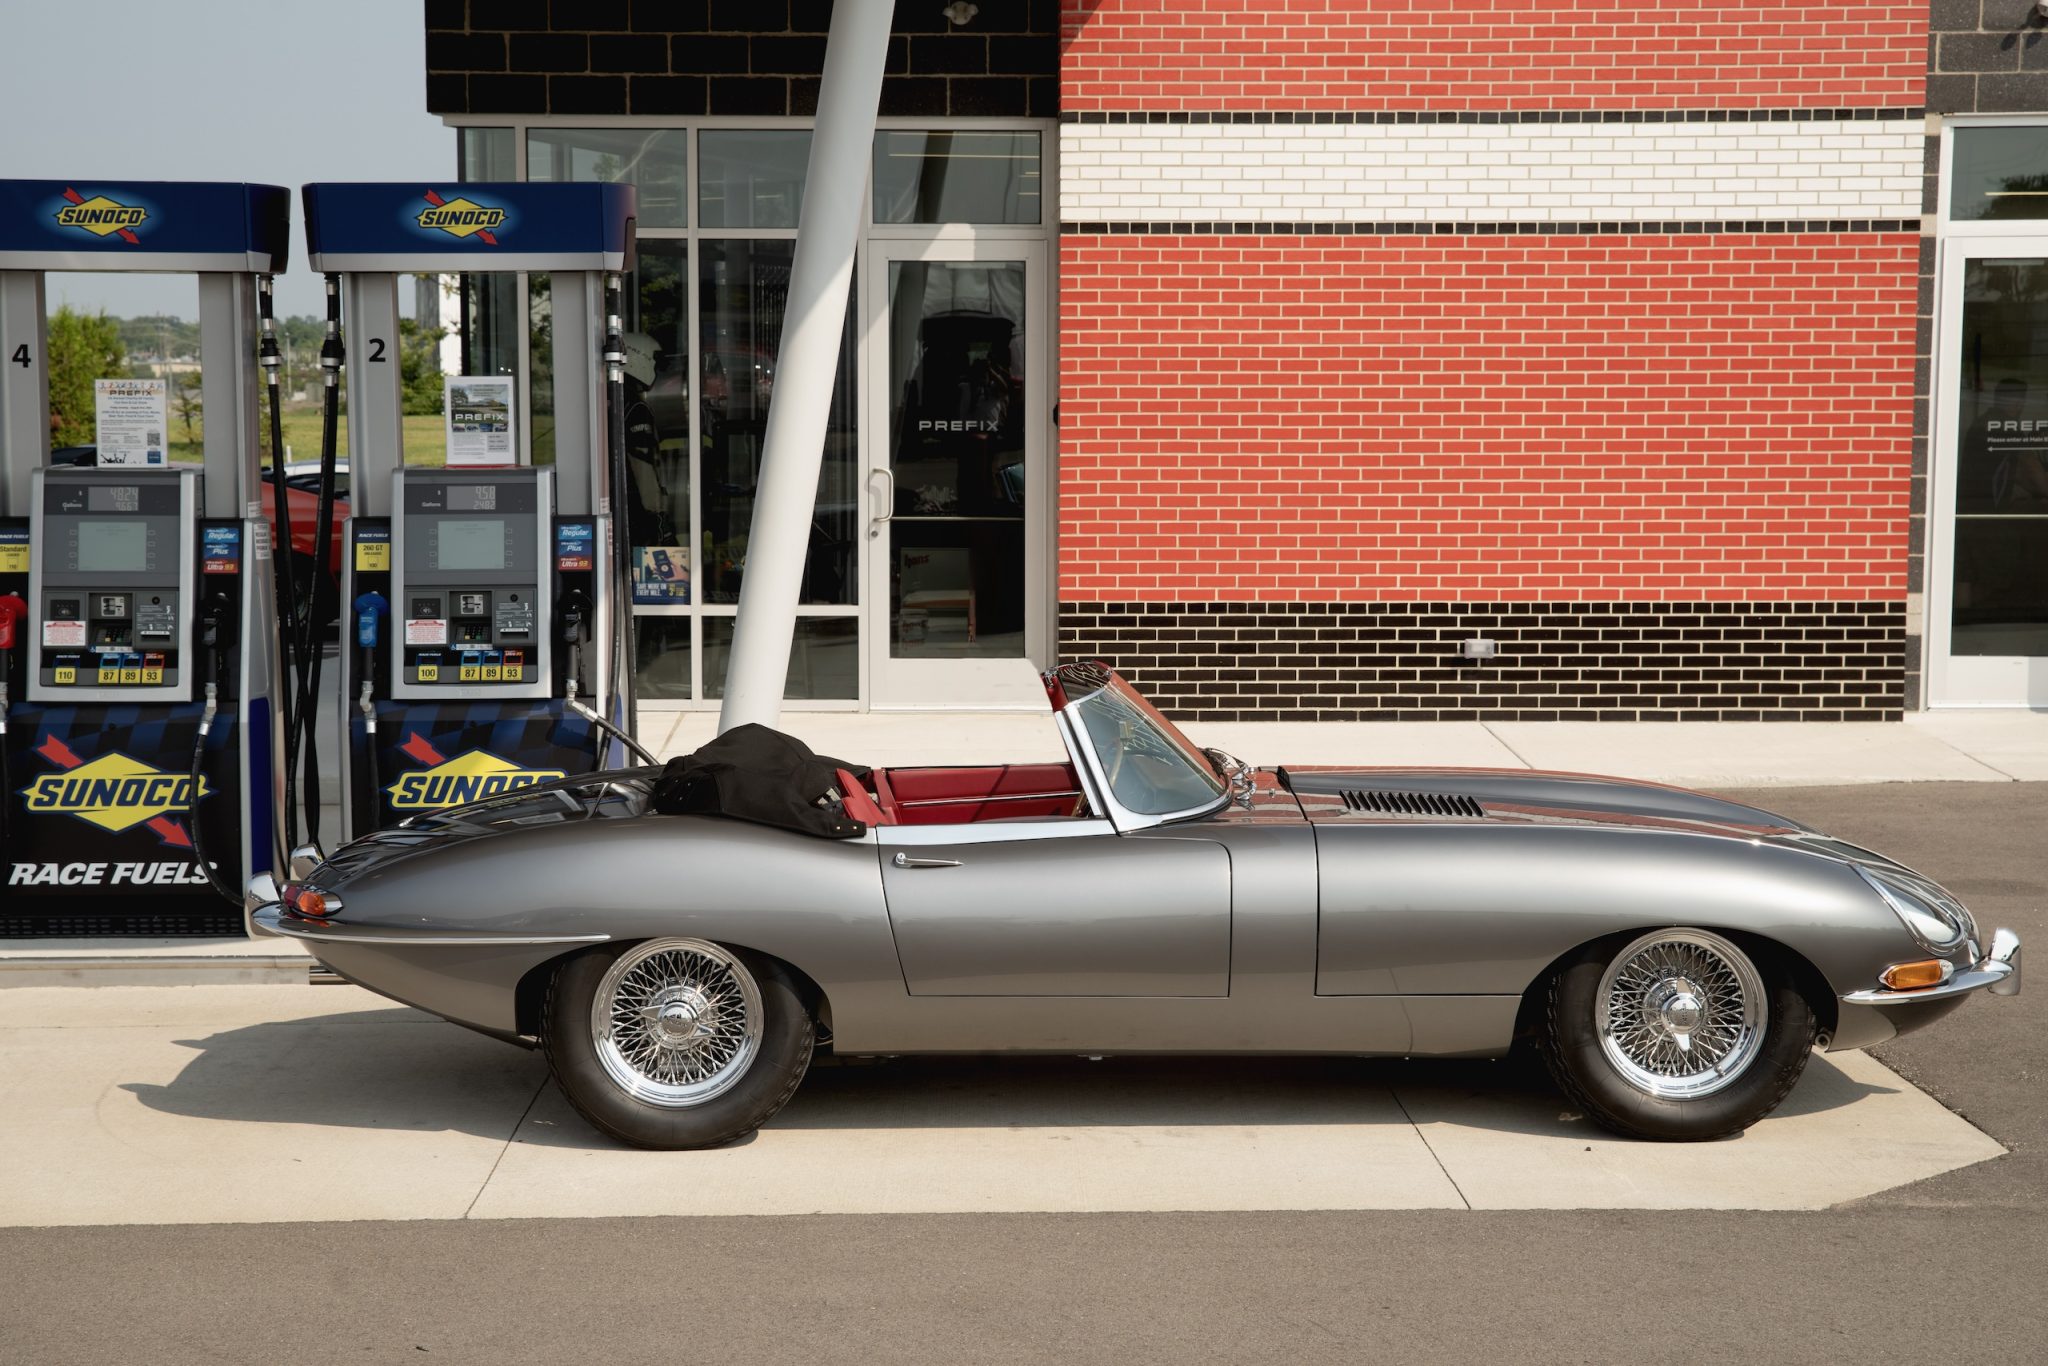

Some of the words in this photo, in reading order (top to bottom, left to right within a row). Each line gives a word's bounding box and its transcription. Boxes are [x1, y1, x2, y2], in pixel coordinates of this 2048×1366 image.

[61, 208, 142, 225] SUNOCO
[421, 210, 502, 225] SUNOCO
[368, 338, 386, 362] 2
[12, 344, 31, 368] 4
[455, 413, 504, 421] PREFIX
[918, 420, 999, 432] PREFIX
[208, 532, 236, 540] Regular
[562, 529, 589, 537] Regular
[561, 560, 578, 568] Ultra
[58, 671, 73, 680] 110
[103, 671, 114, 681] 87
[125, 671, 136, 681] 89
[146, 671, 157, 681] 93
[421, 669, 436, 678] 100
[465, 669, 475, 678] 87
[486, 669, 497, 678] 89
[507, 669, 518, 678] 93
[397, 776, 562, 804] SUNO
[8, 862, 109, 886] RACE
